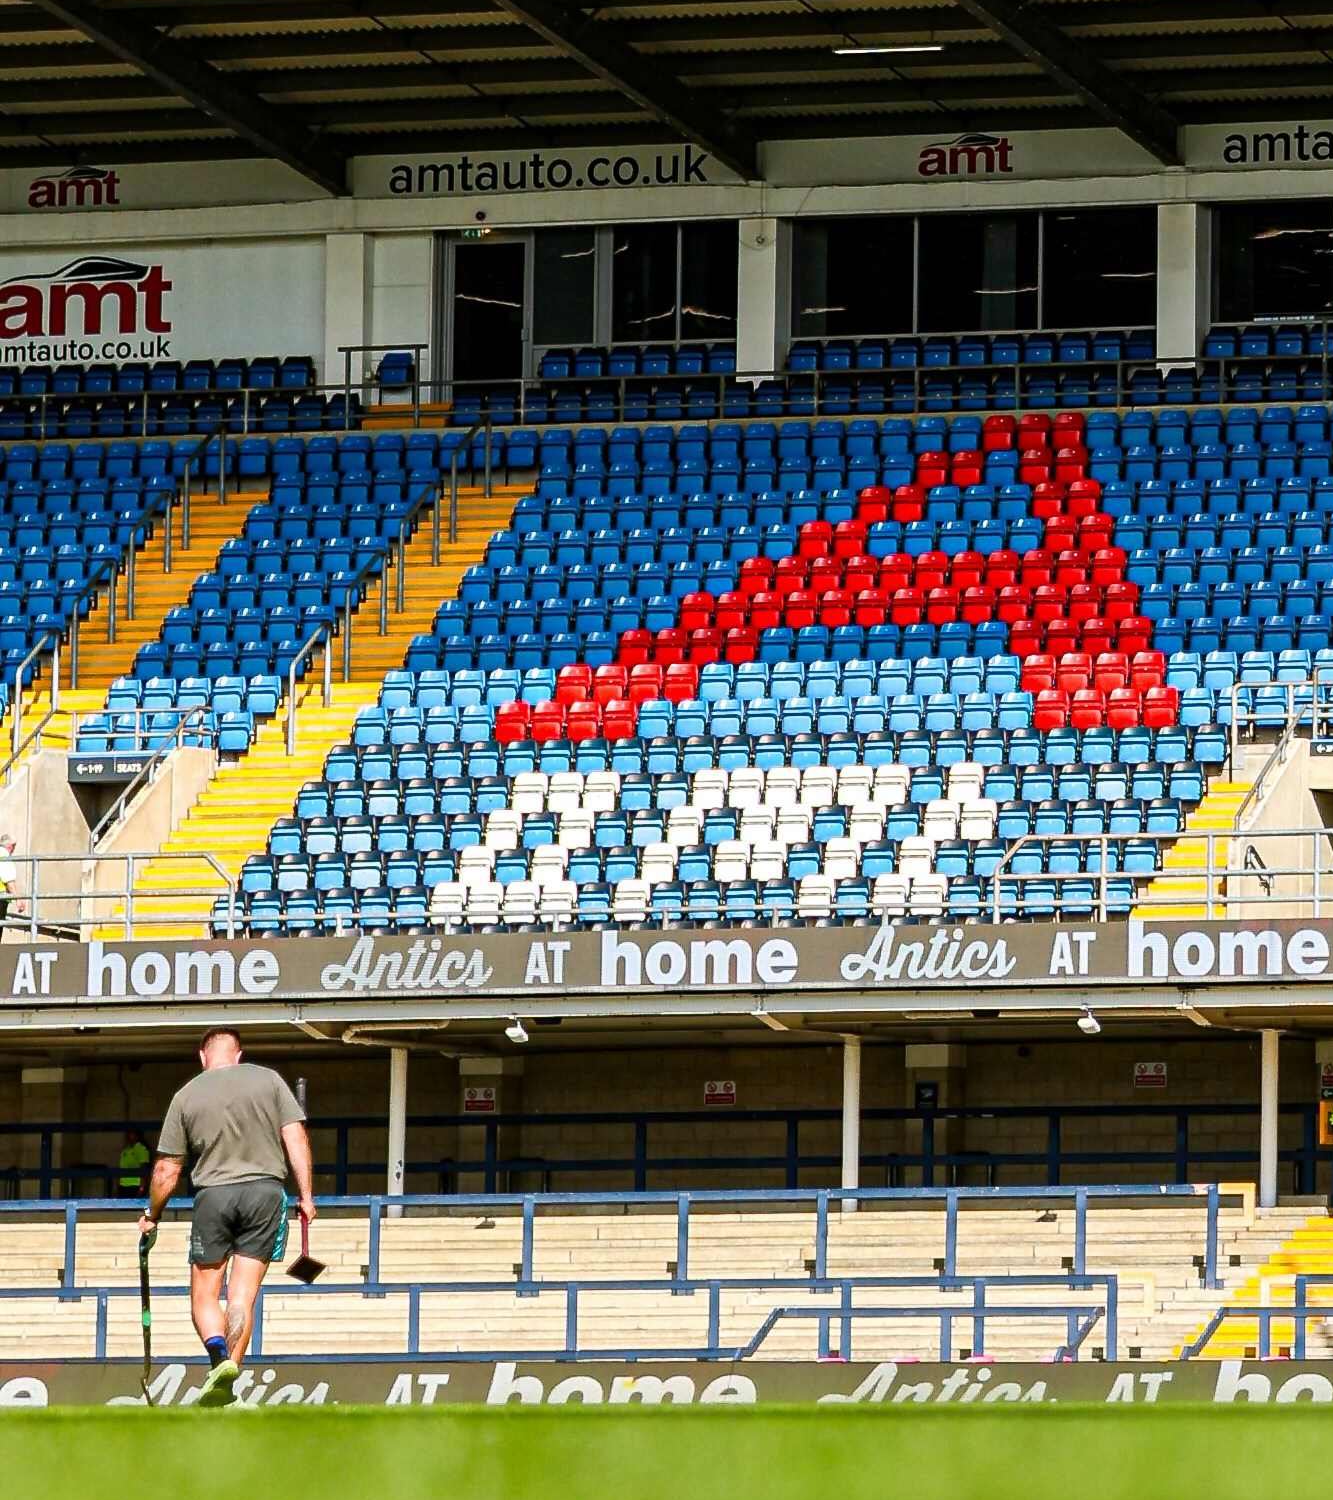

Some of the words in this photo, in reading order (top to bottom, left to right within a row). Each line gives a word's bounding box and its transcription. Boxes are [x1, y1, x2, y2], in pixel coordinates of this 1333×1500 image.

[389, 143, 708, 195] amtauto.co.uk
[917, 137, 1013, 177] amt
[27, 170, 120, 208] amt
[0, 266, 172, 339] amt
[0, 335, 171, 363] mtauto.co.uk
[116, 763, 142, 774] SEATS
[13, 952, 57, 995] AT
[88, 941, 280, 996] home
[321, 936, 493, 991] Antics
[524, 941, 572, 984] AT
[600, 930, 799, 985] home
[841, 925, 1016, 982] Antics
[1049, 931, 1097, 975] AT
[1127, 921, 1331, 977] home
[384, 1372, 450, 1405] AT
[1105, 1371, 1173, 1403] AT
